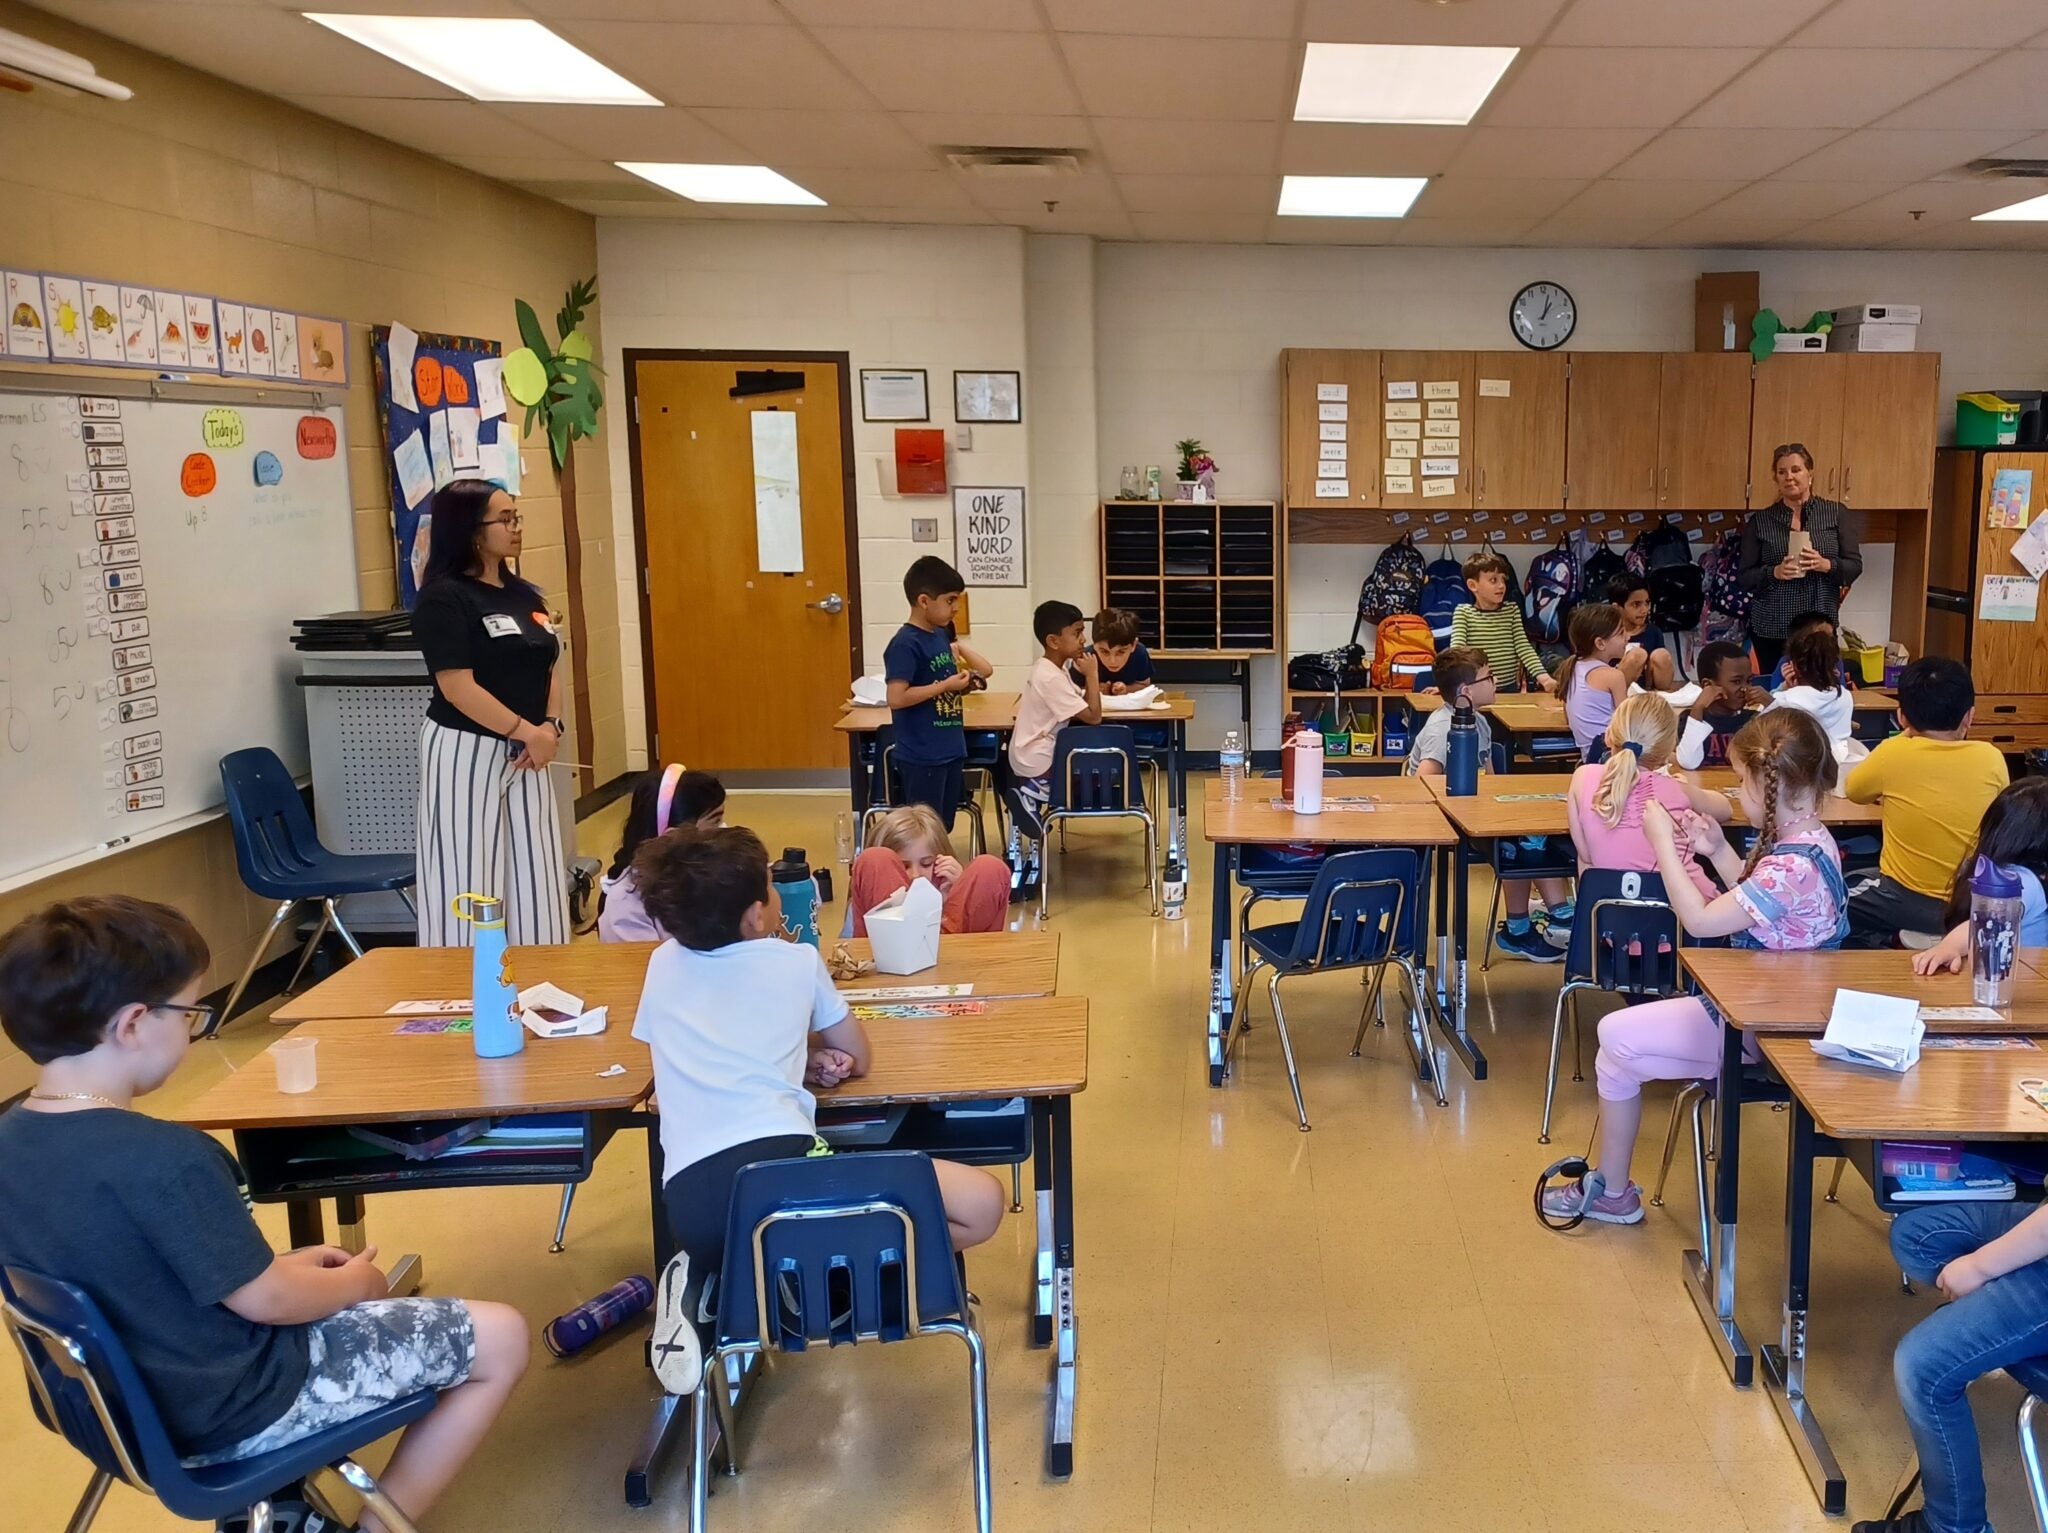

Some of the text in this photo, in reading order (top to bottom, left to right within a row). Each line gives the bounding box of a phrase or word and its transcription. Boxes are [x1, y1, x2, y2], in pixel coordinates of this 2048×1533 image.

[10, 278, 18, 298] R
[48, 282, 57, 301] S
[86, 288, 96, 305] T
[124, 293, 132, 309] U
[157, 296, 164, 313] V
[188, 302, 197, 317] W
[221, 308, 228, 322] X
[247, 312, 254, 327] Y
[274, 316, 281, 331] Z
[207, 418, 240, 443] Today's
[972, 495, 1006, 515] ONE
[185, 510, 198, 534] Up
[968, 515, 1011, 536] KIND
[967, 536, 1013, 555] WORD
[967, 556, 1014, 565] CAN CHANGE
